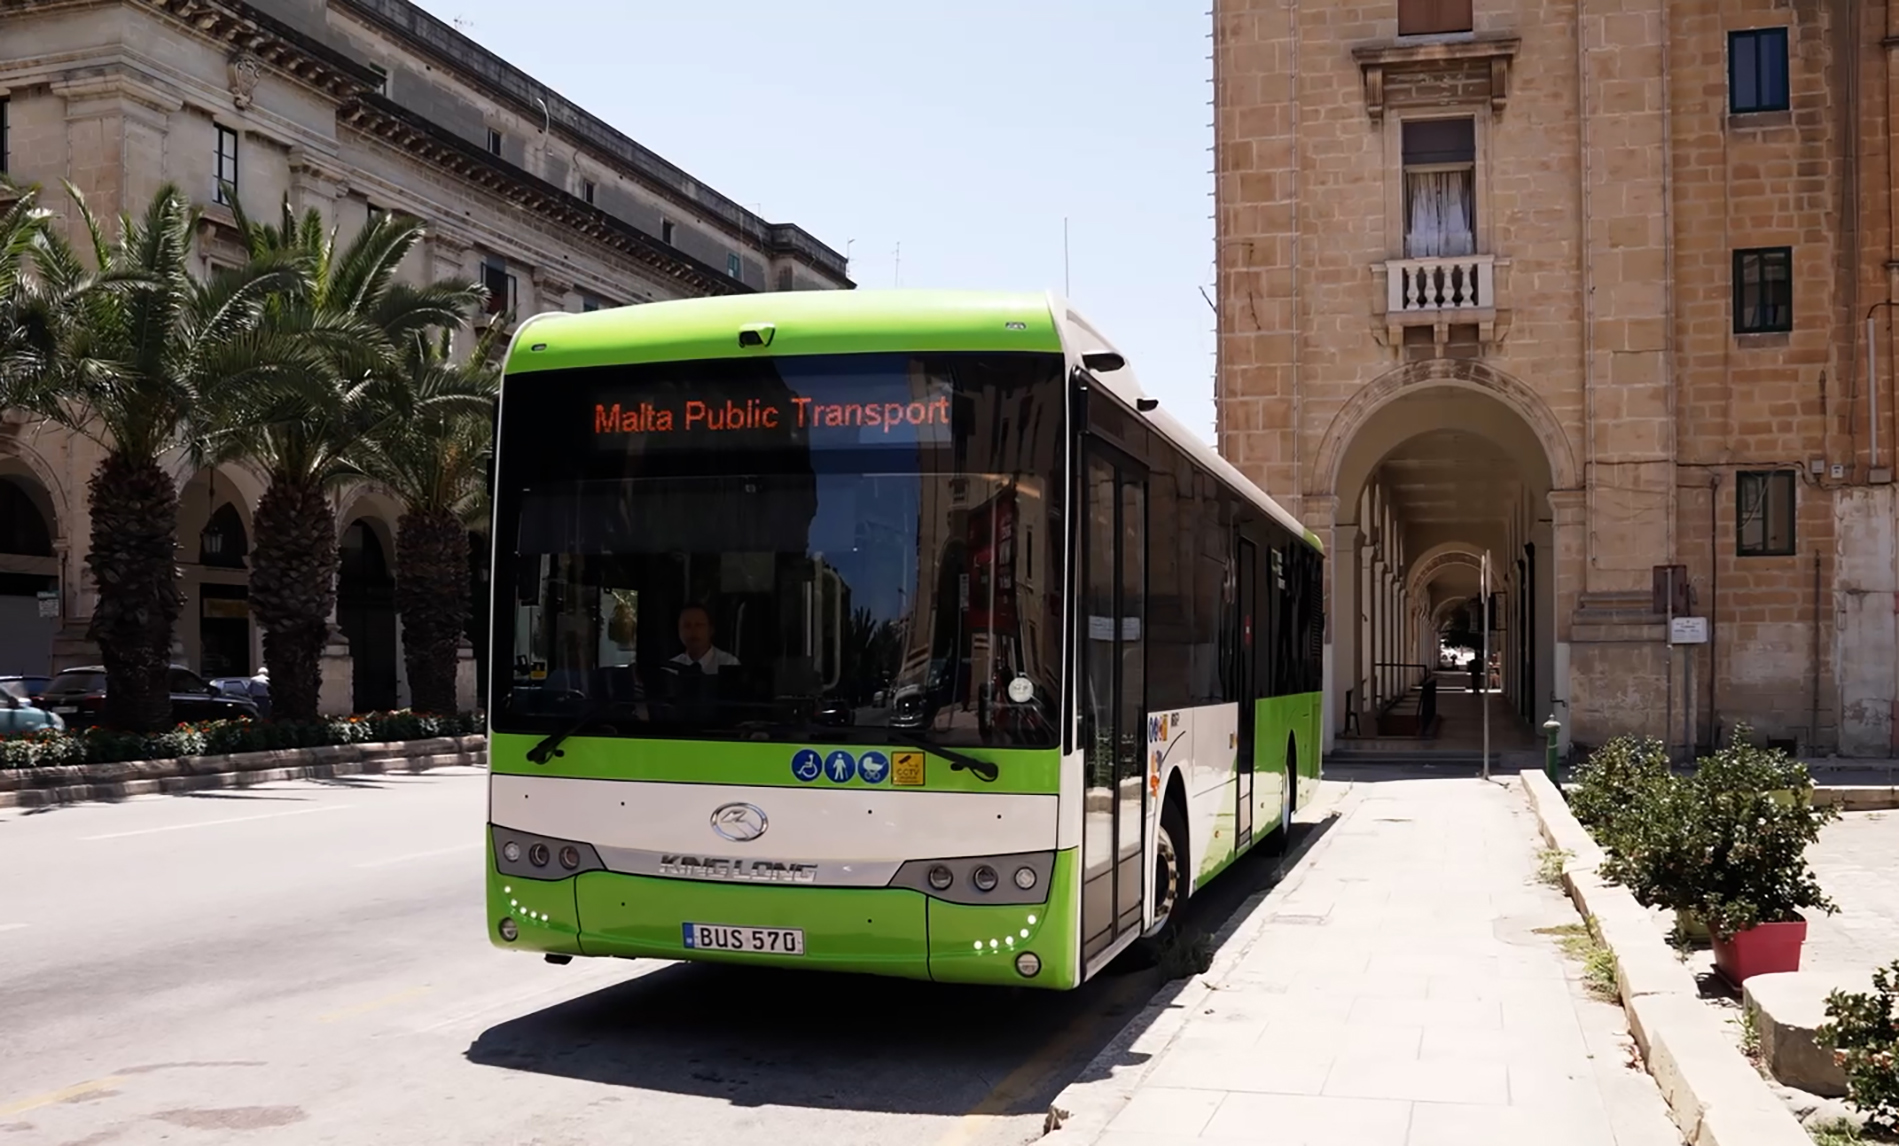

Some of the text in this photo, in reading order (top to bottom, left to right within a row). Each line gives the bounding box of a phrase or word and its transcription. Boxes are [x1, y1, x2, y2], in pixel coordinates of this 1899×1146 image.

[594, 396, 950, 433] Malta Public Transport
[896, 768, 920, 776] CCTV
[700, 927, 796, 952] BUS 570
